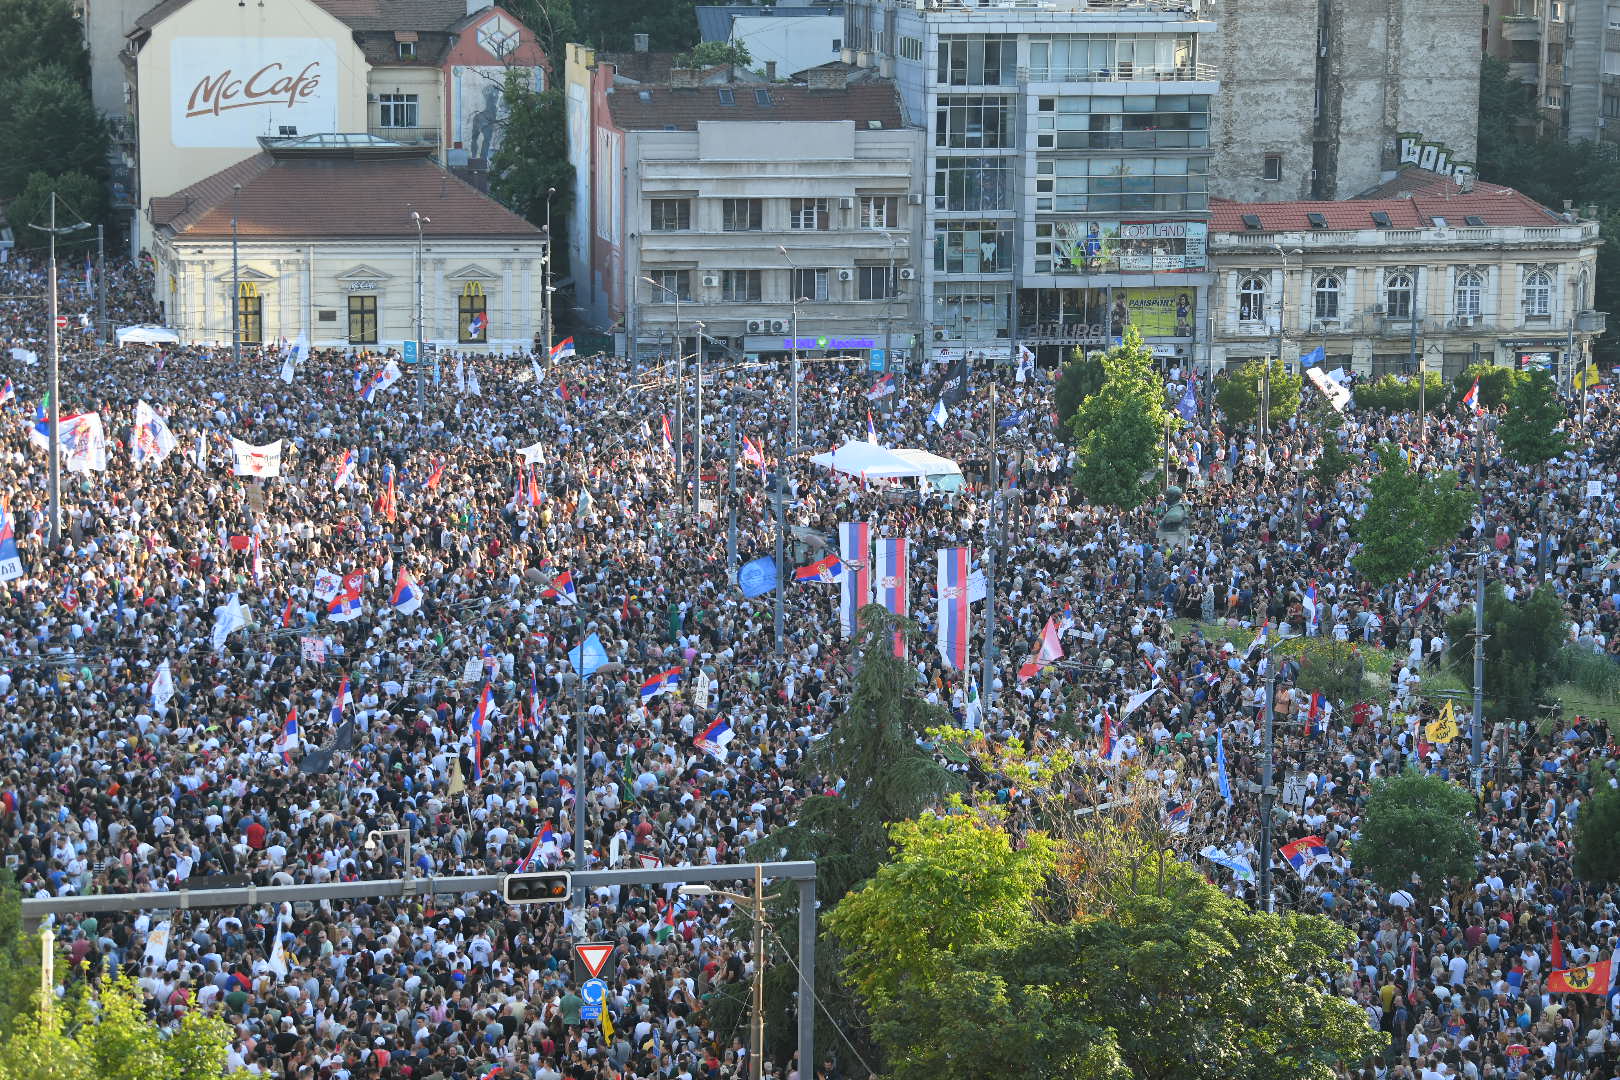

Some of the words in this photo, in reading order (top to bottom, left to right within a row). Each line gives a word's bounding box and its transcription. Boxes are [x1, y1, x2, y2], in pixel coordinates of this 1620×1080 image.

[186, 61, 321, 117] McCafé
[1122, 225, 1151, 237] COPY
[1154, 224, 1185, 237] LAND
[1027, 323, 1104, 339] FUTURA
